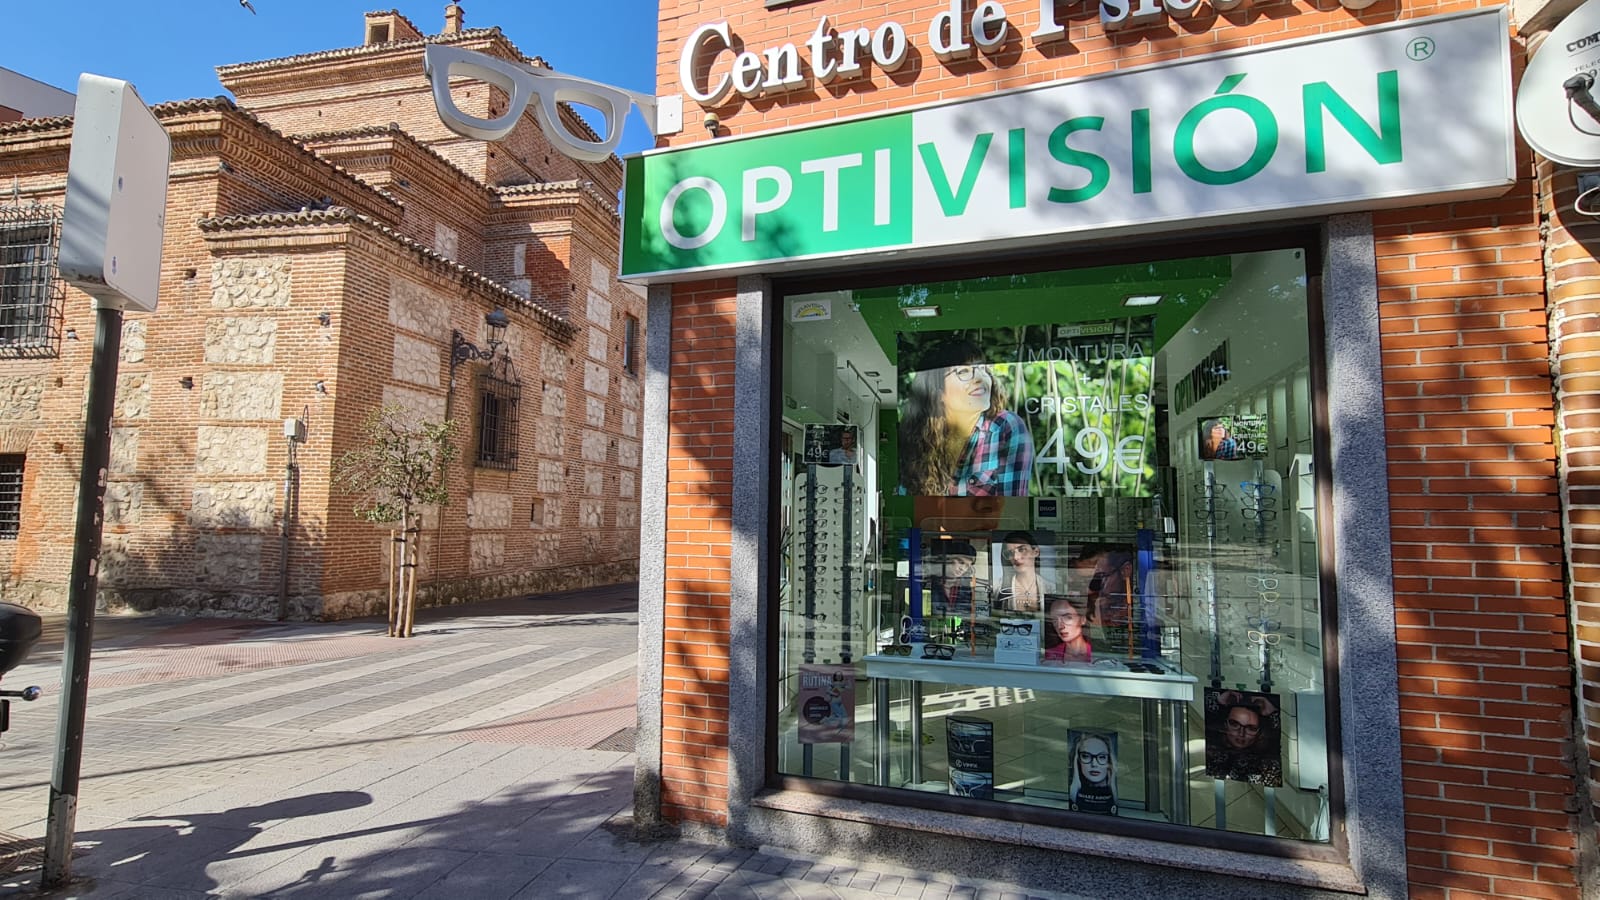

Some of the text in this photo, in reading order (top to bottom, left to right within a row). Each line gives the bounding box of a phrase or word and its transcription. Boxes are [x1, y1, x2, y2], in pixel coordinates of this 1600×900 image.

[679, 15, 908, 101] Centro
[928, 0, 1008, 53] de
[659, 70, 1403, 250] OPTIVISIÓN
[1028, 342, 1144, 363] MONTURA
[1024, 394, 1149, 415] CRISTALES
[807, 447, 829, 458] 49€
[1036, 427, 1145, 475] 49€
[1236, 439, 1268, 454] 49€
